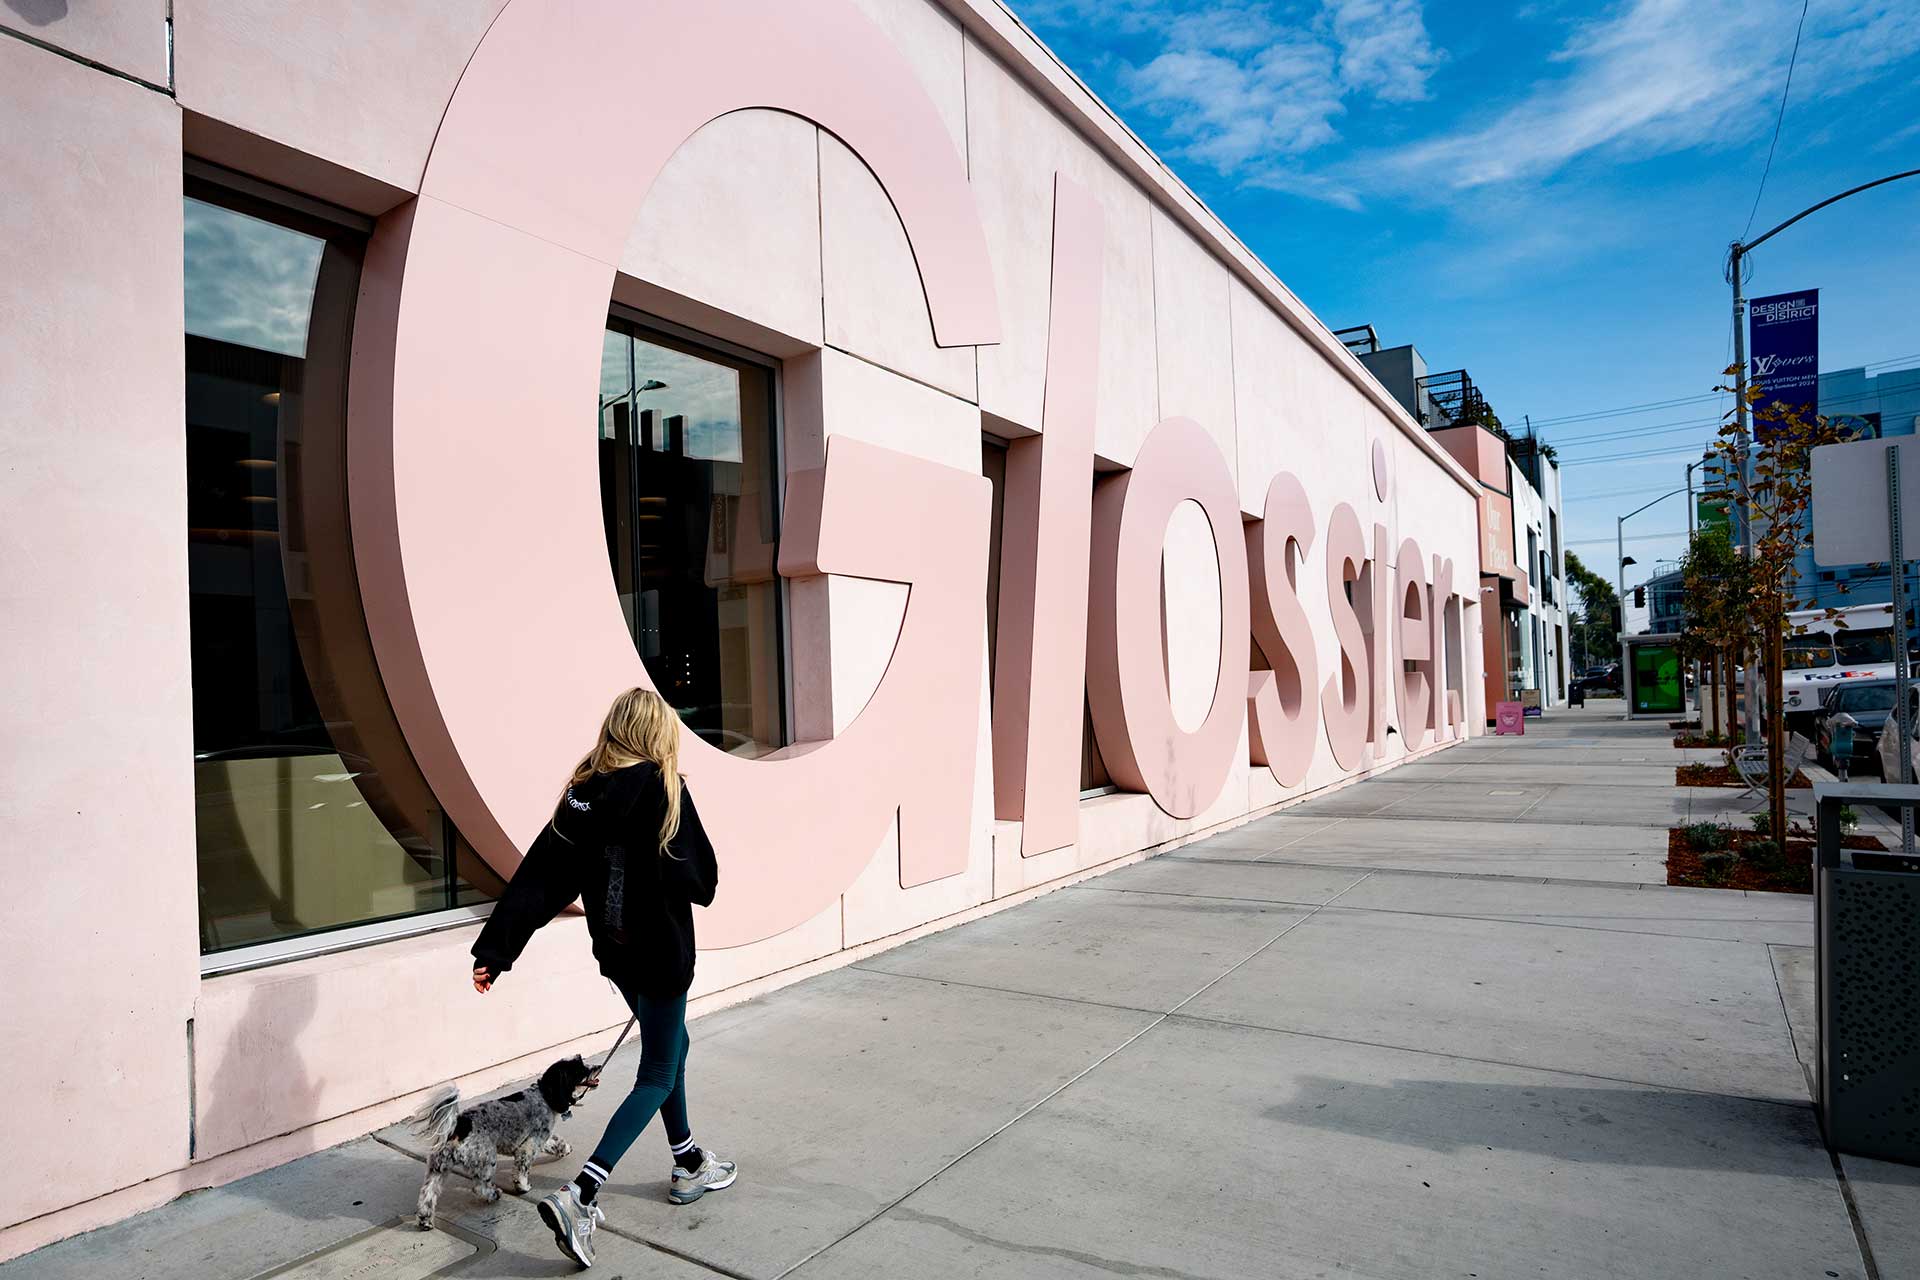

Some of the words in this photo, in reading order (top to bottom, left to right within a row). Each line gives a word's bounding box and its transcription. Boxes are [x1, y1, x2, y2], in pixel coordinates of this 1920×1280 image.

[1752, 300, 1796, 315] DESIGN
[1766, 304, 1817, 322] DISTRICT
[1772, 376, 1800, 384] VUITTON
[1804, 671, 1876, 681] FedEx
